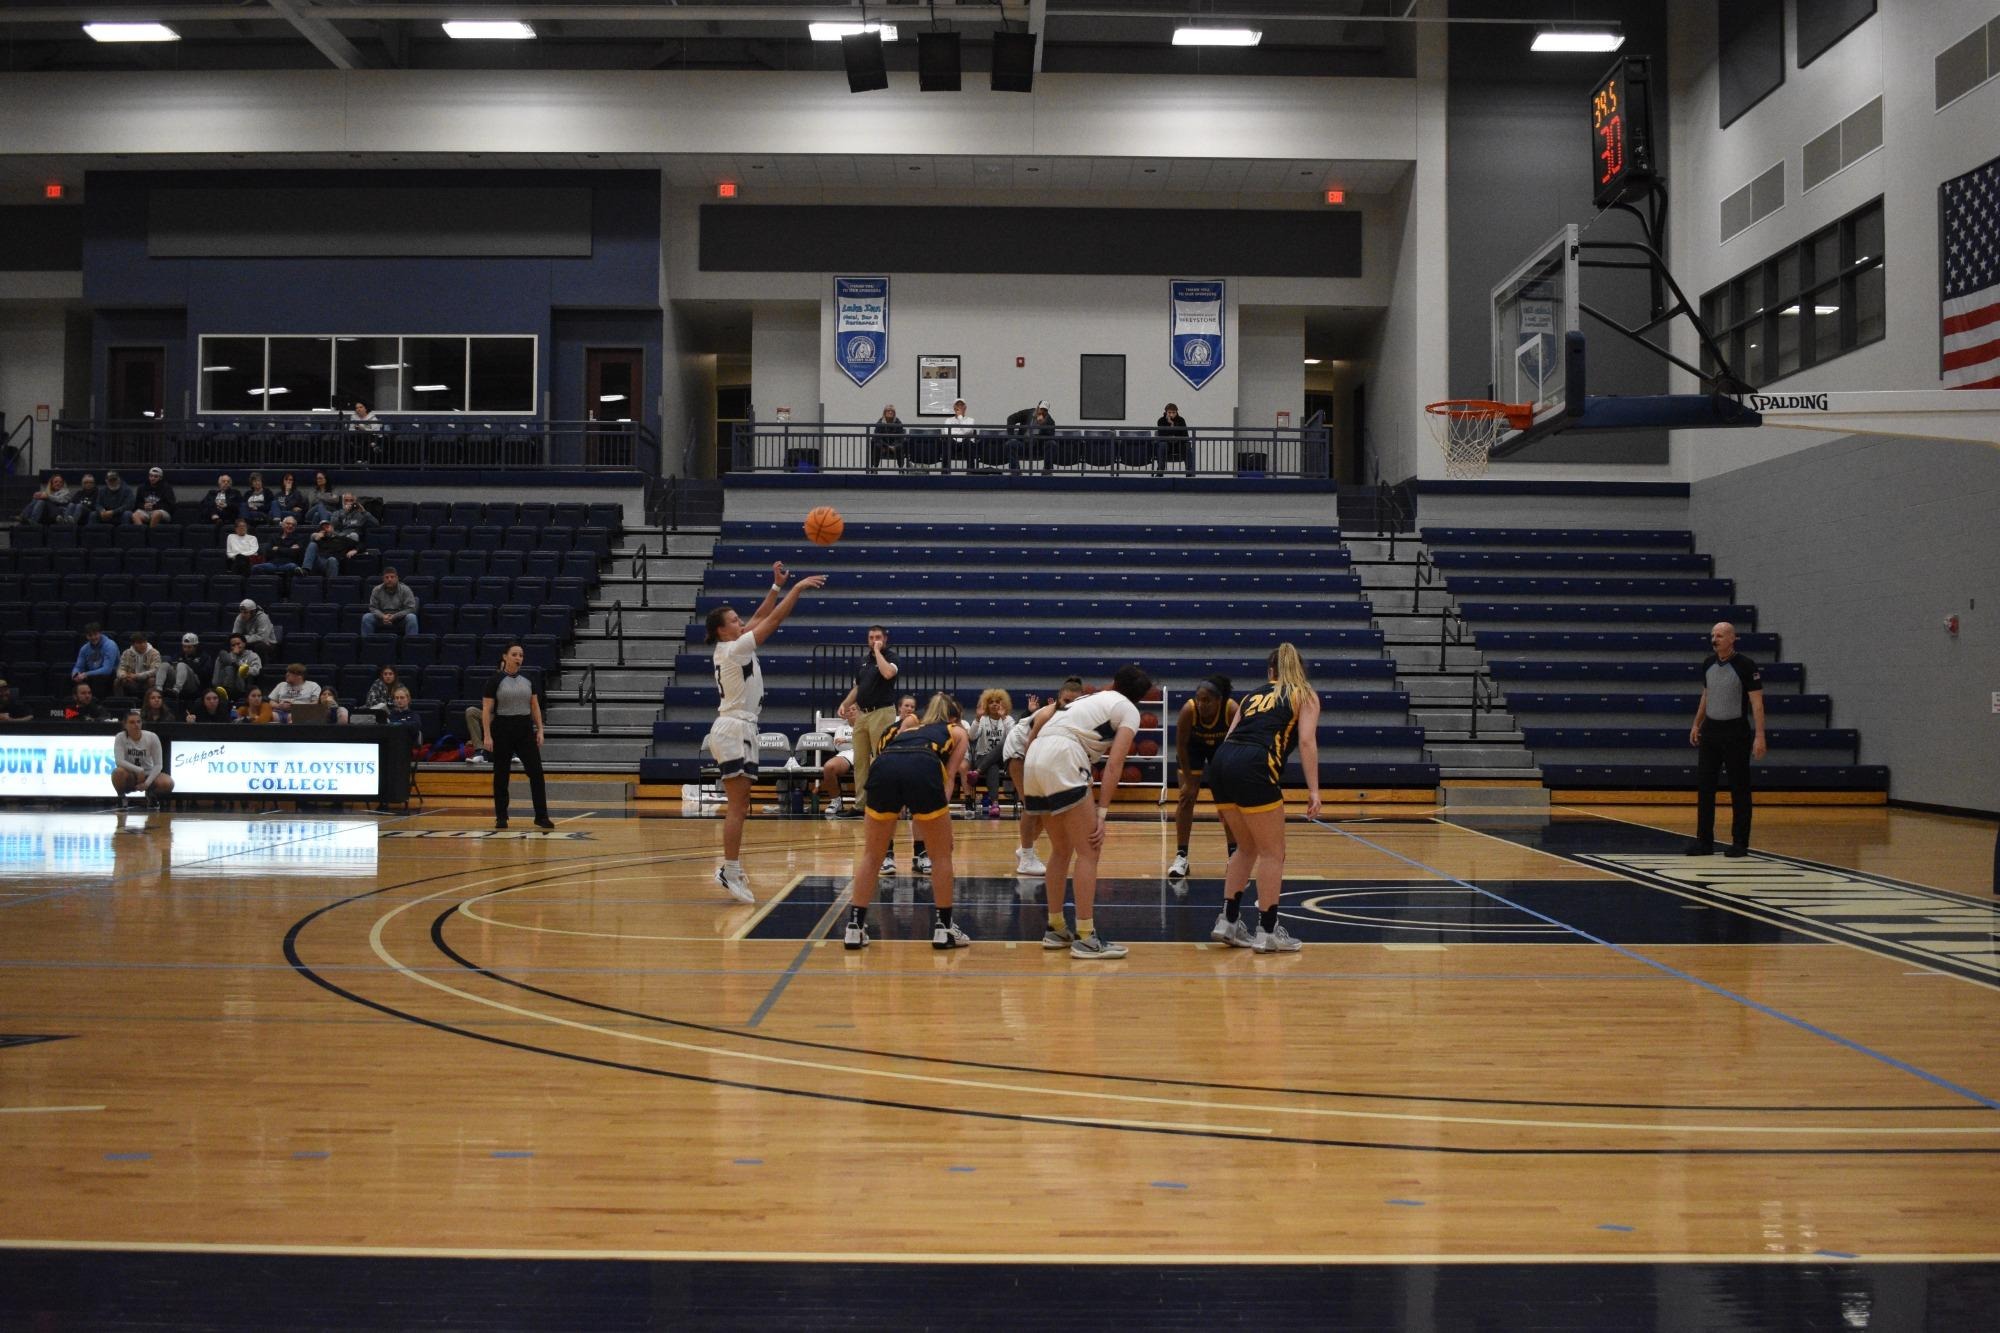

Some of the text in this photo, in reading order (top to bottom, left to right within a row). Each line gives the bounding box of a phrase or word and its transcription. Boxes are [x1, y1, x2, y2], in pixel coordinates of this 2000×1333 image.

[1600, 115, 1622, 184] 30
[1750, 393, 1828, 411] SPALDING
[1244, 692, 1276, 717] 20
[54, 749, 115, 775] ALOYS
[127, 748, 147, 757] MOUNT
[175, 745, 225, 768] Support
[207, 761, 376, 775] MOUNT ALOYSIUS
[248, 778, 338, 791] COLLEGE
